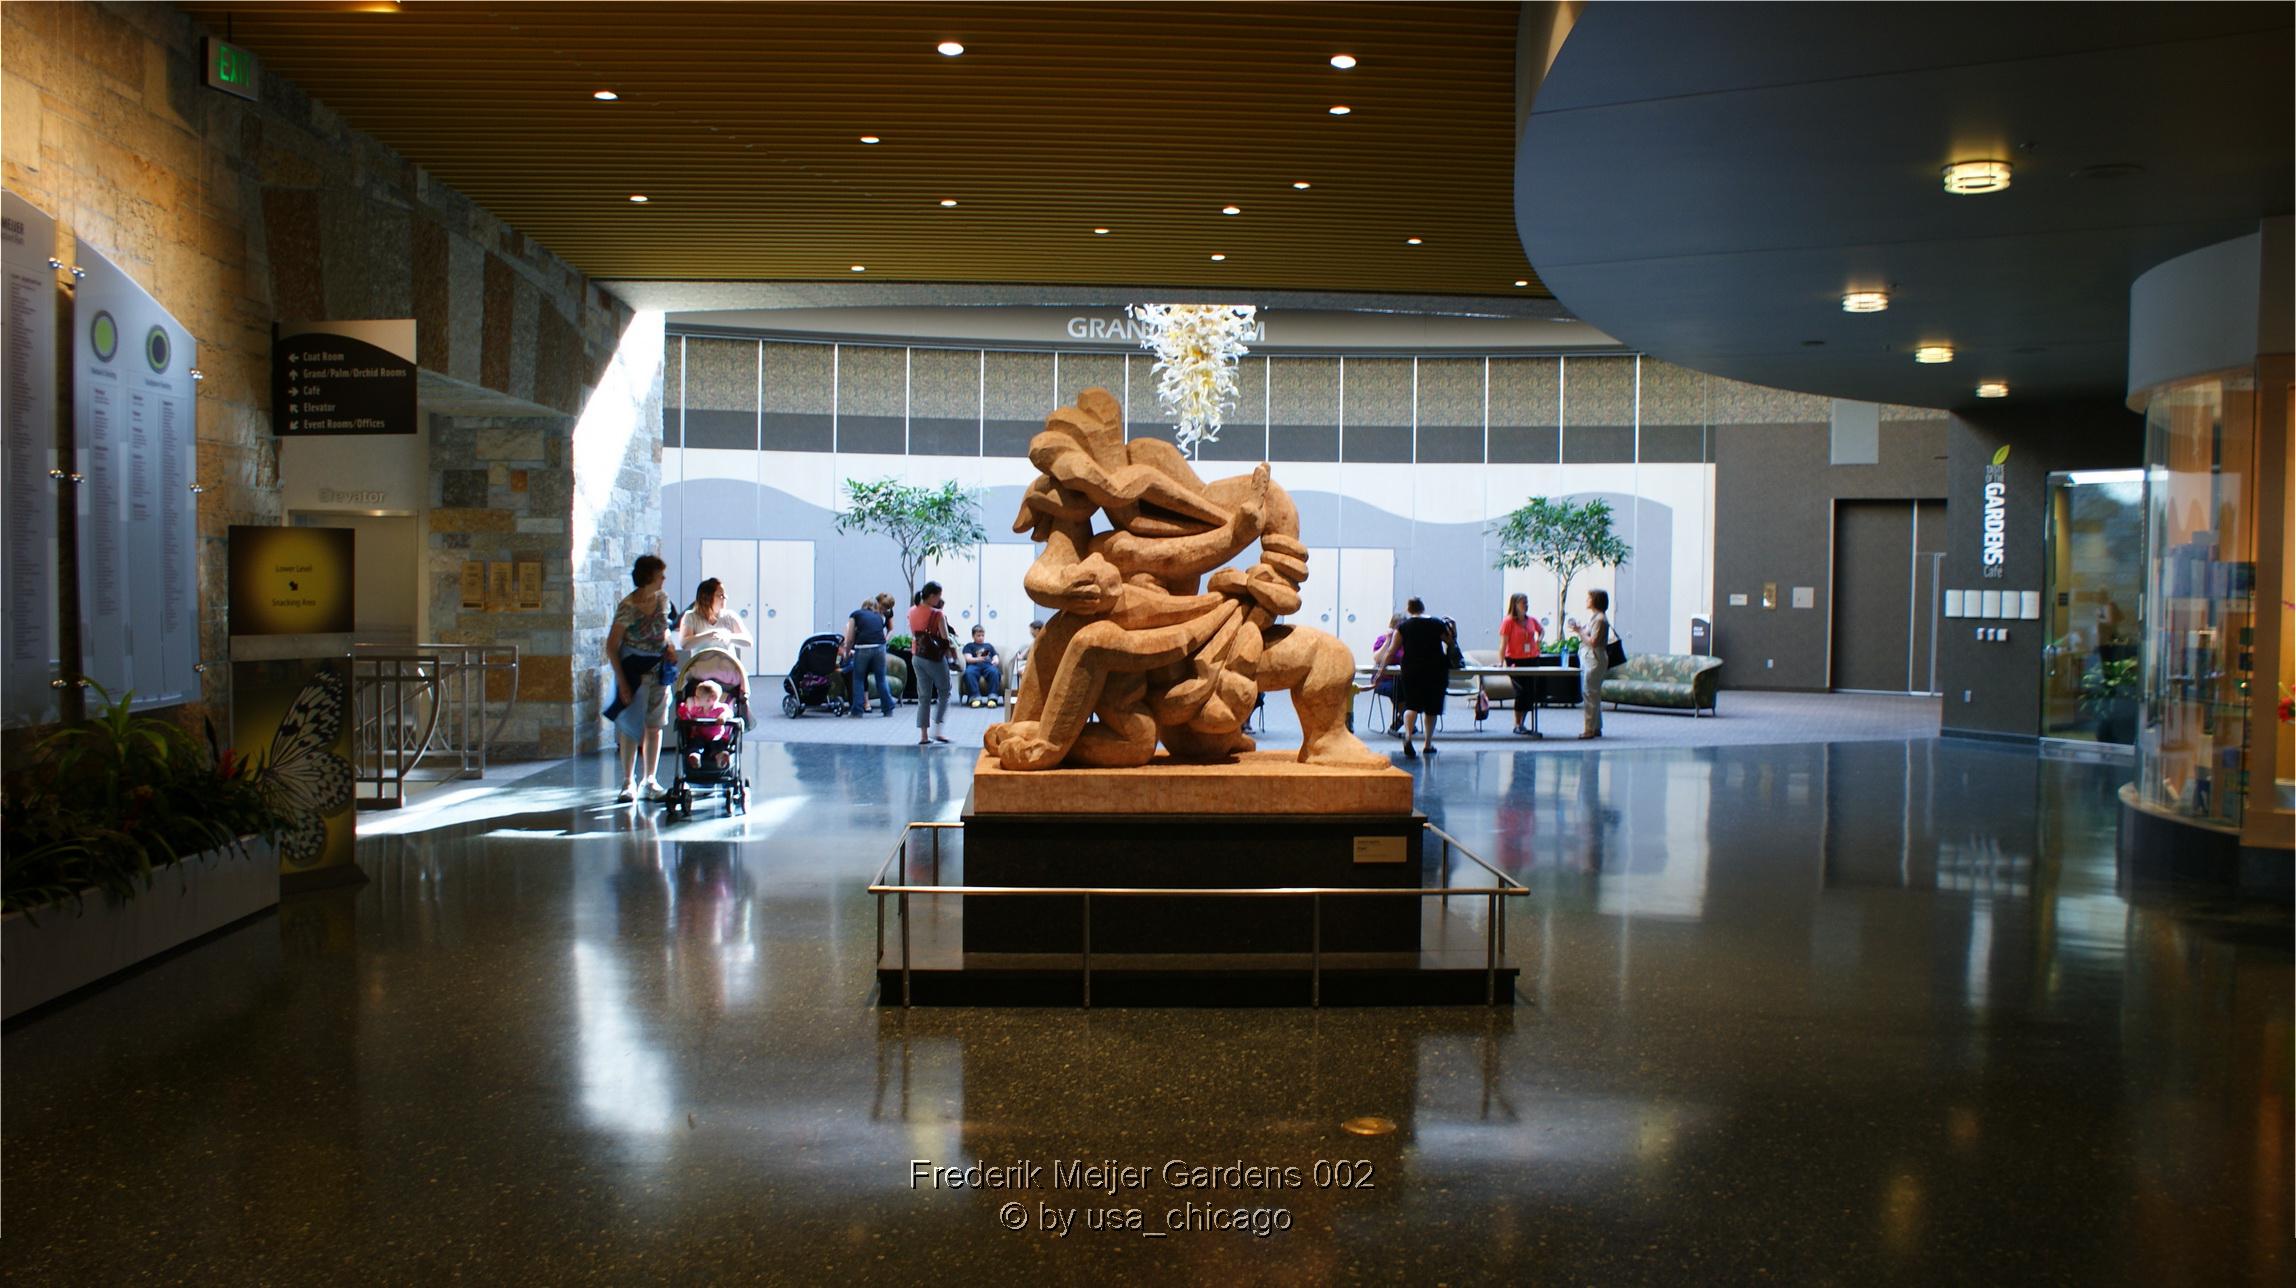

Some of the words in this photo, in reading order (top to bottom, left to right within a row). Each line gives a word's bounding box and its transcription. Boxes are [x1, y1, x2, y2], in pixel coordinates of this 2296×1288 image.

[220, 45, 251, 88] EXIT
[303, 352, 321, 362] Coat
[322, 352, 345, 361] Room
[380, 368, 407, 378] Rooms
[303, 402, 337, 413] Elevator
[303, 419, 326, 430] Event
[318, 487, 385, 504] Elevator
[1984, 482, 2006, 566] GARDENS
